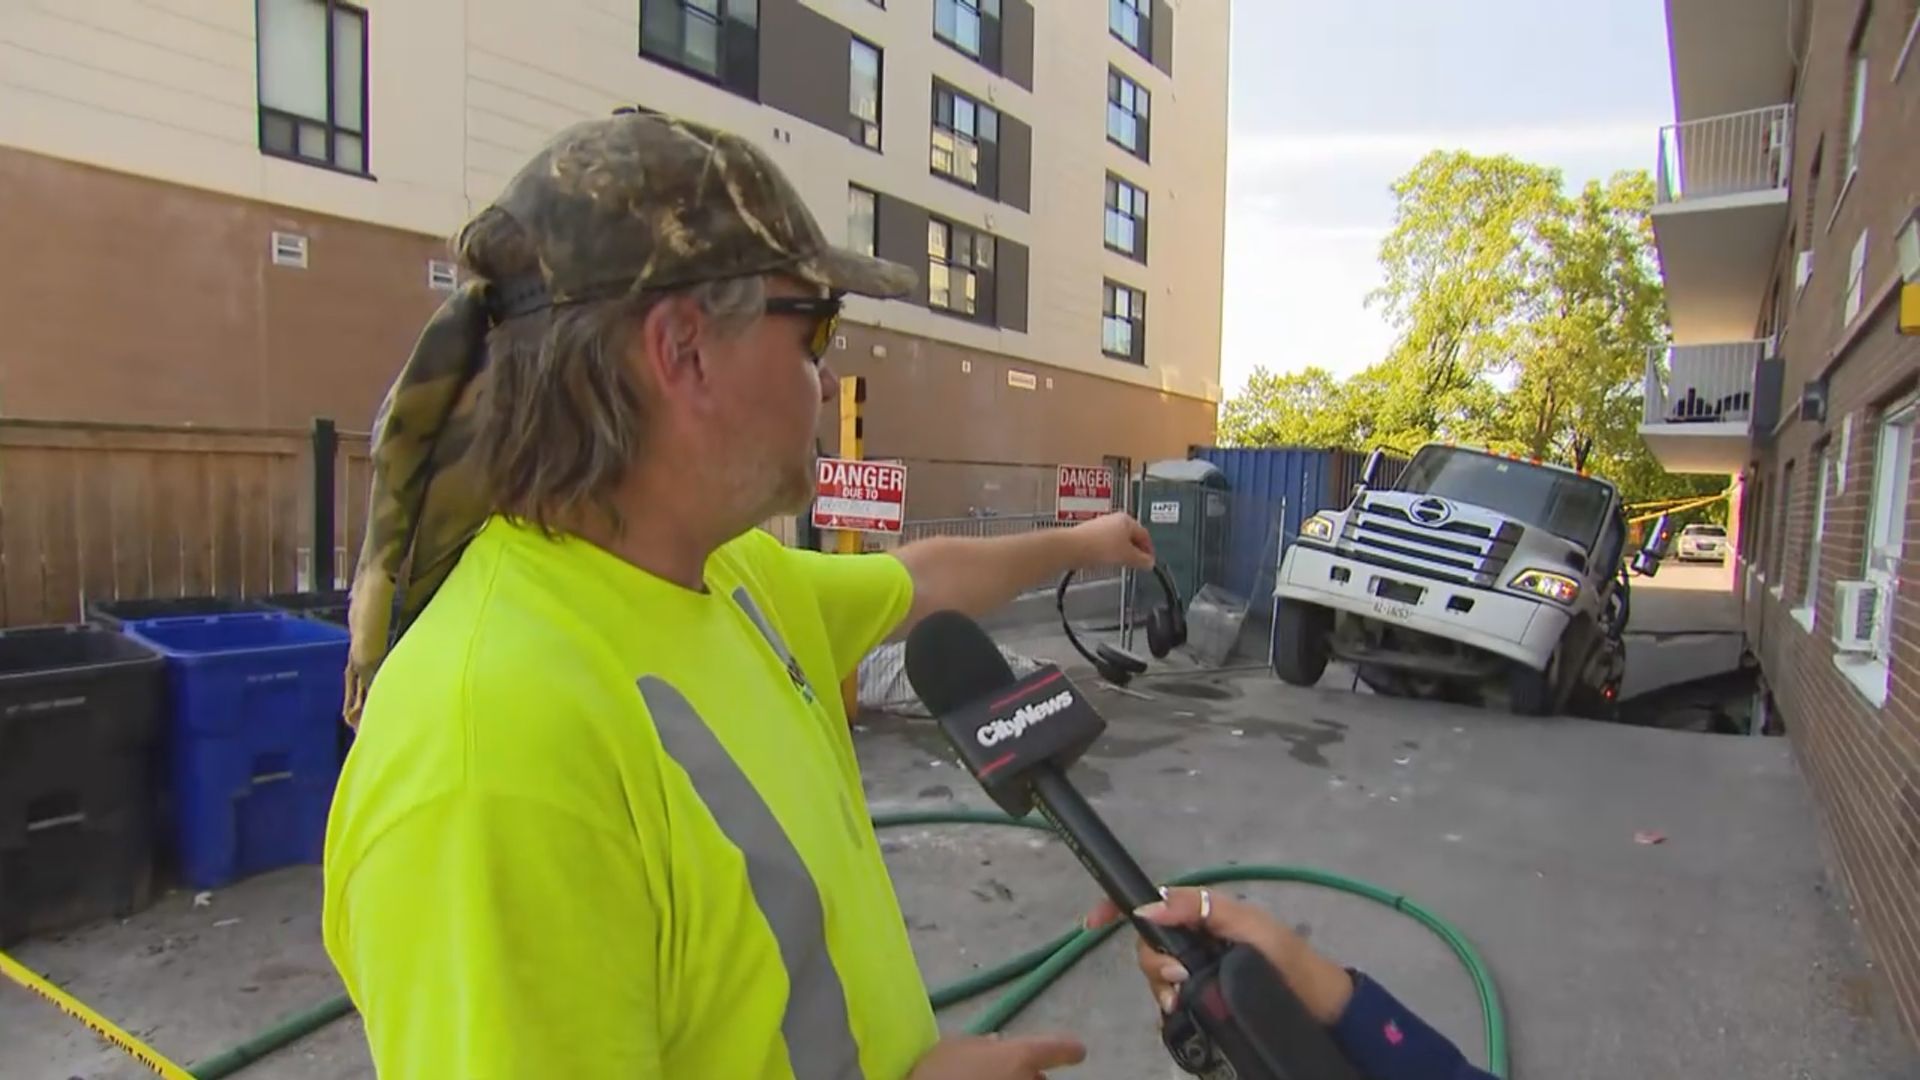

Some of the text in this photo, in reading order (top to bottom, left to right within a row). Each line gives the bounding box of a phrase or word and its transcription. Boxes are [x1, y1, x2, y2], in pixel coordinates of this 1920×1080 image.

[820, 462, 902, 491] DANGER
[1060, 468, 1111, 488] DANGER
[842, 486, 879, 500] DUE TO
[976, 690, 1074, 747] CityNews
